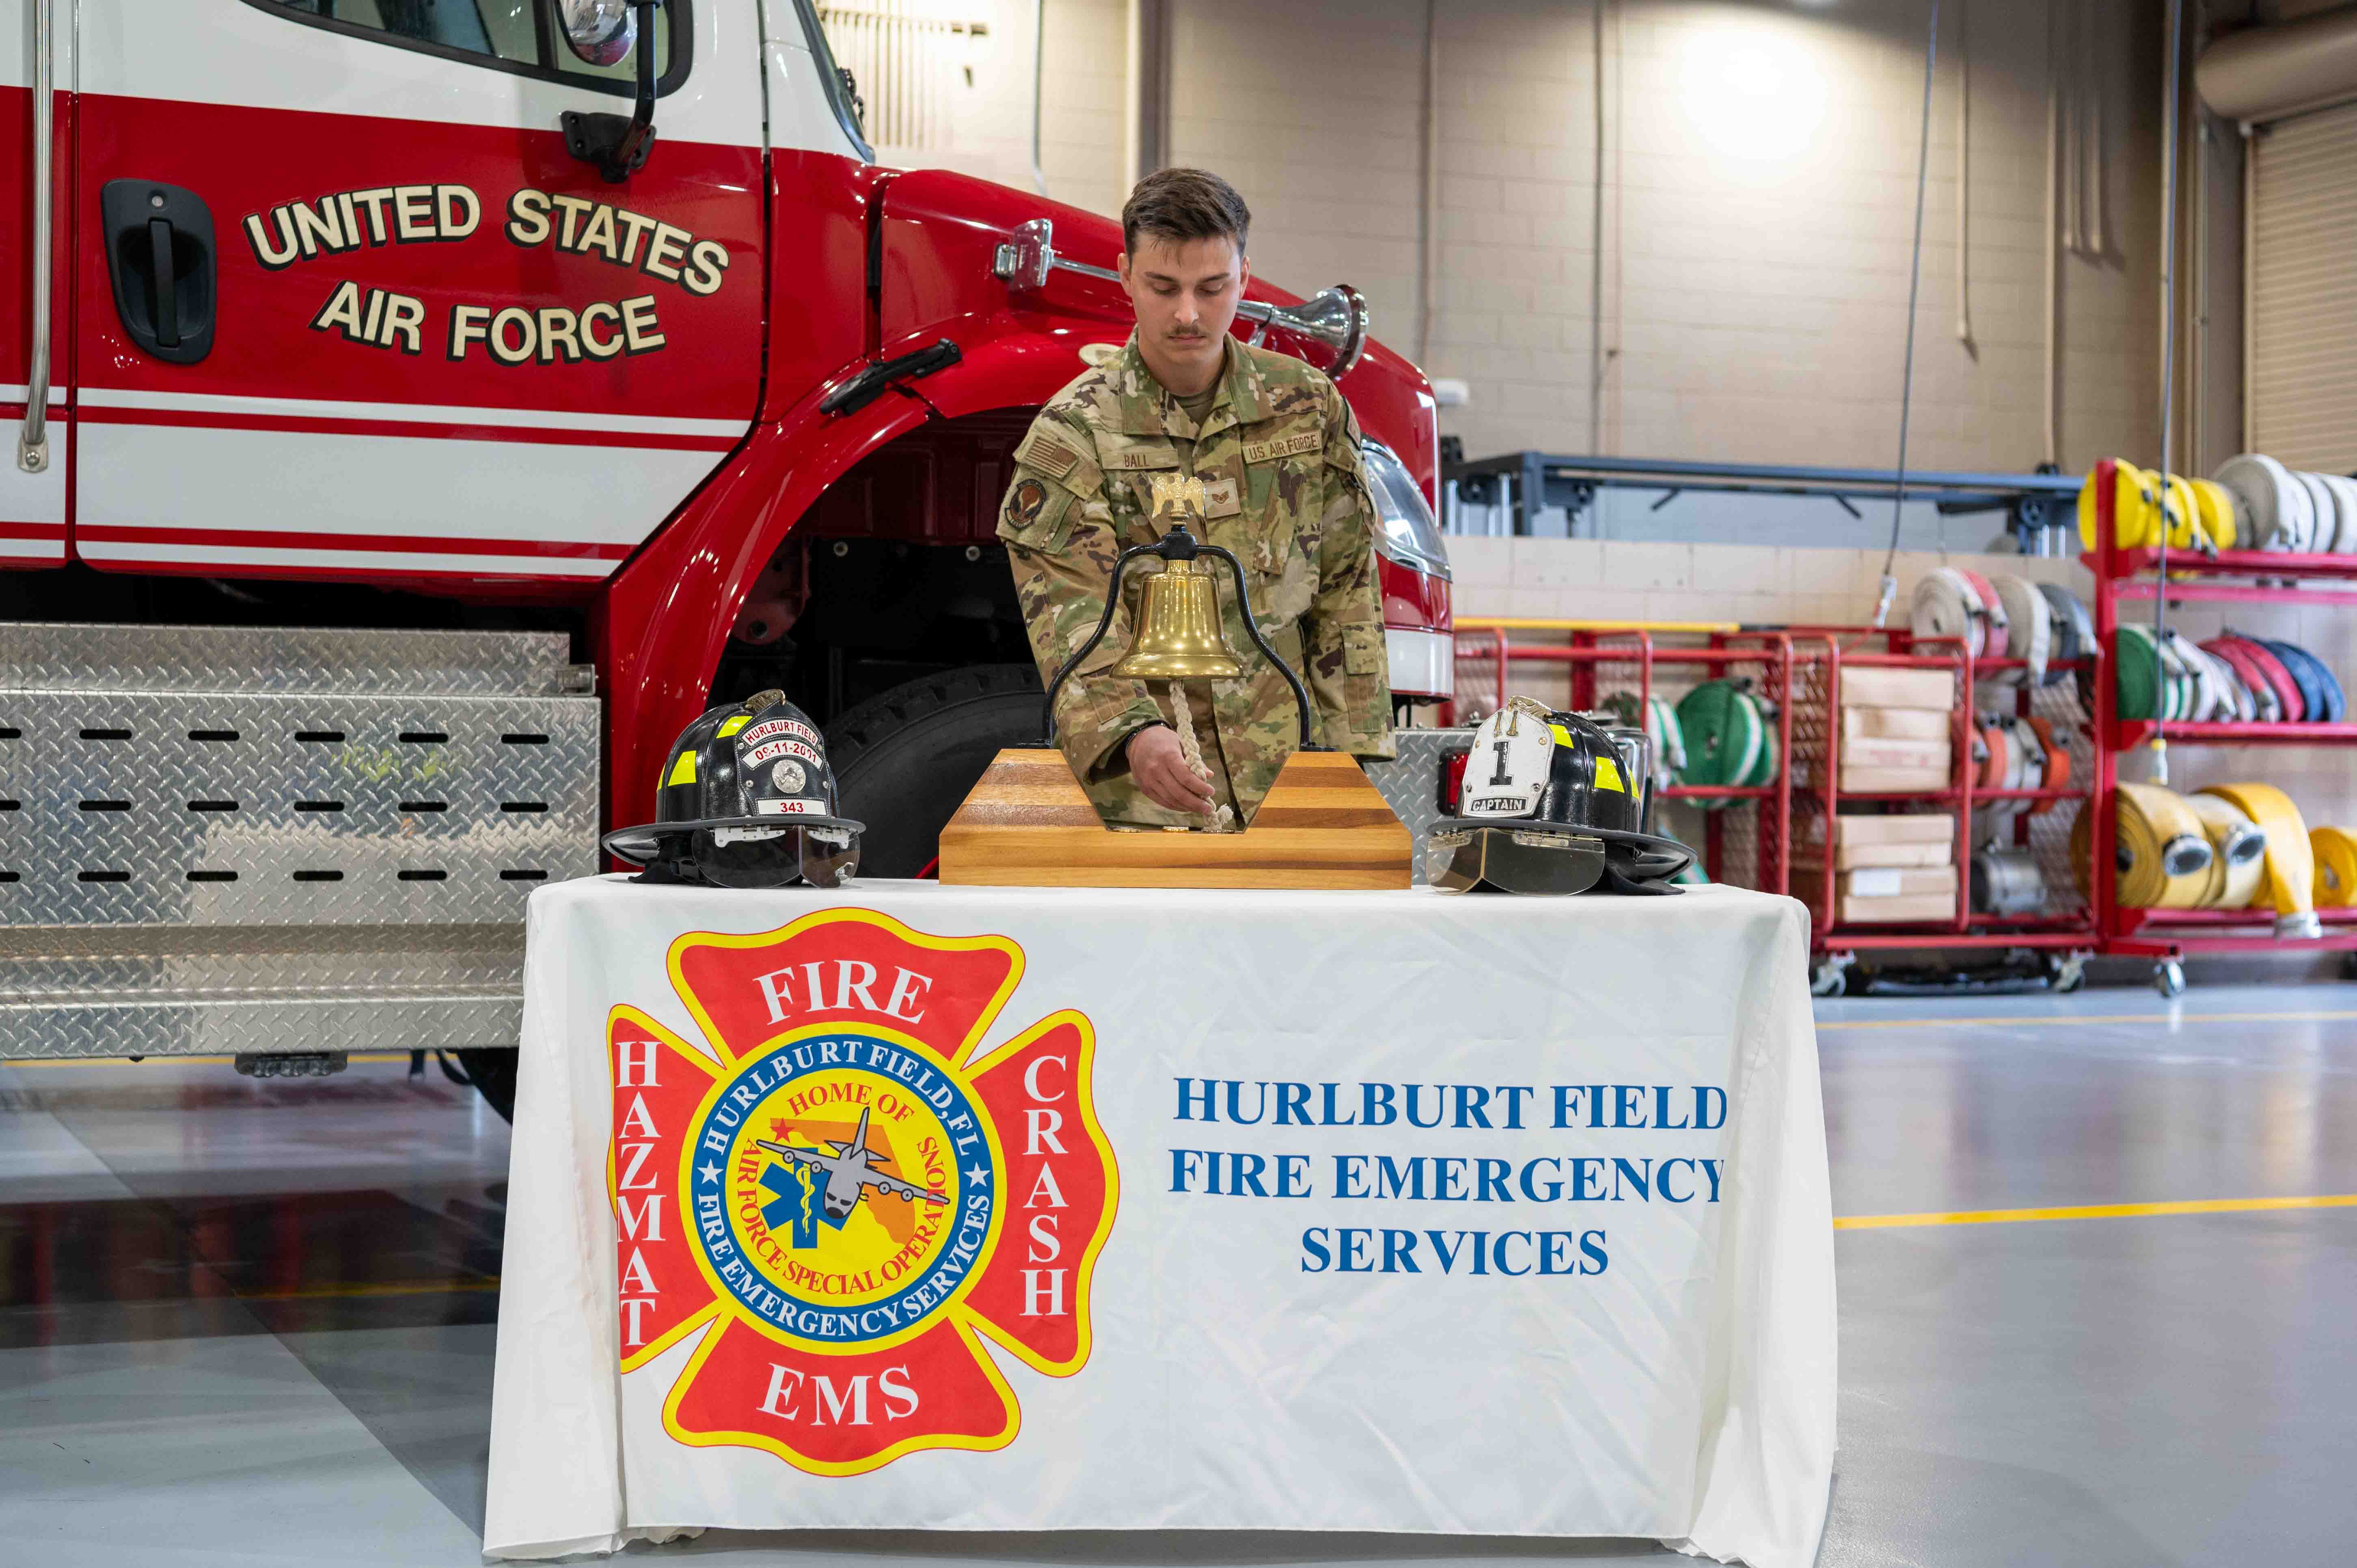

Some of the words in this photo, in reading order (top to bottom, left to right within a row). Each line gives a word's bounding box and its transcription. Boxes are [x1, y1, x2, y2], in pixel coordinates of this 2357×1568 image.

[244, 185, 481, 271] UNITED
[505, 188, 729, 296] STATES
[309, 281, 425, 354] AIR
[446, 295, 665, 366] FORCE
[1124, 454, 1150, 467] BALL
[1270, 442, 1286, 456] AIR
[1286, 435, 1318, 453] FORCE
[745, 721, 795, 743] HURLBURT
[797, 725, 816, 744] FIELD
[755, 742, 816, 763] 09-11-2001
[1488, 741, 1514, 787] 1
[780, 802, 803, 813] 343
[1472, 799, 1522, 811] CAPTAIN
[753, 959, 933, 1025] FIRE
[703, 1041, 862, 1156] HURLBURT
[786, 1083, 872, 1117] HOME
[878, 1094, 915, 1123] OF
[1173, 1077, 1533, 1130] HURLBURT
[1549, 1085, 1727, 1130] FIELD
[737, 1137, 763, 1184] AIR
[1019, 1055, 1068, 1316] CRASH
[1168, 1149, 1312, 1198] FIRE
[1331, 1155, 1724, 1203] EMERGENCY
[615, 1042, 666, 1346] HAZMAT
[881, 1137, 946, 1281] OPERATIONS
[737, 1188, 788, 1271] FORCE
[1301, 1227, 1608, 1276] SERVICES
[698, 1192, 734, 1261] FIRE
[720, 1256, 901, 1336] EMERGENCY
[902, 1195, 990, 1319] SERVICES
[783, 1260, 883, 1295] SPECIAL
[757, 1363, 919, 1426] EMS
